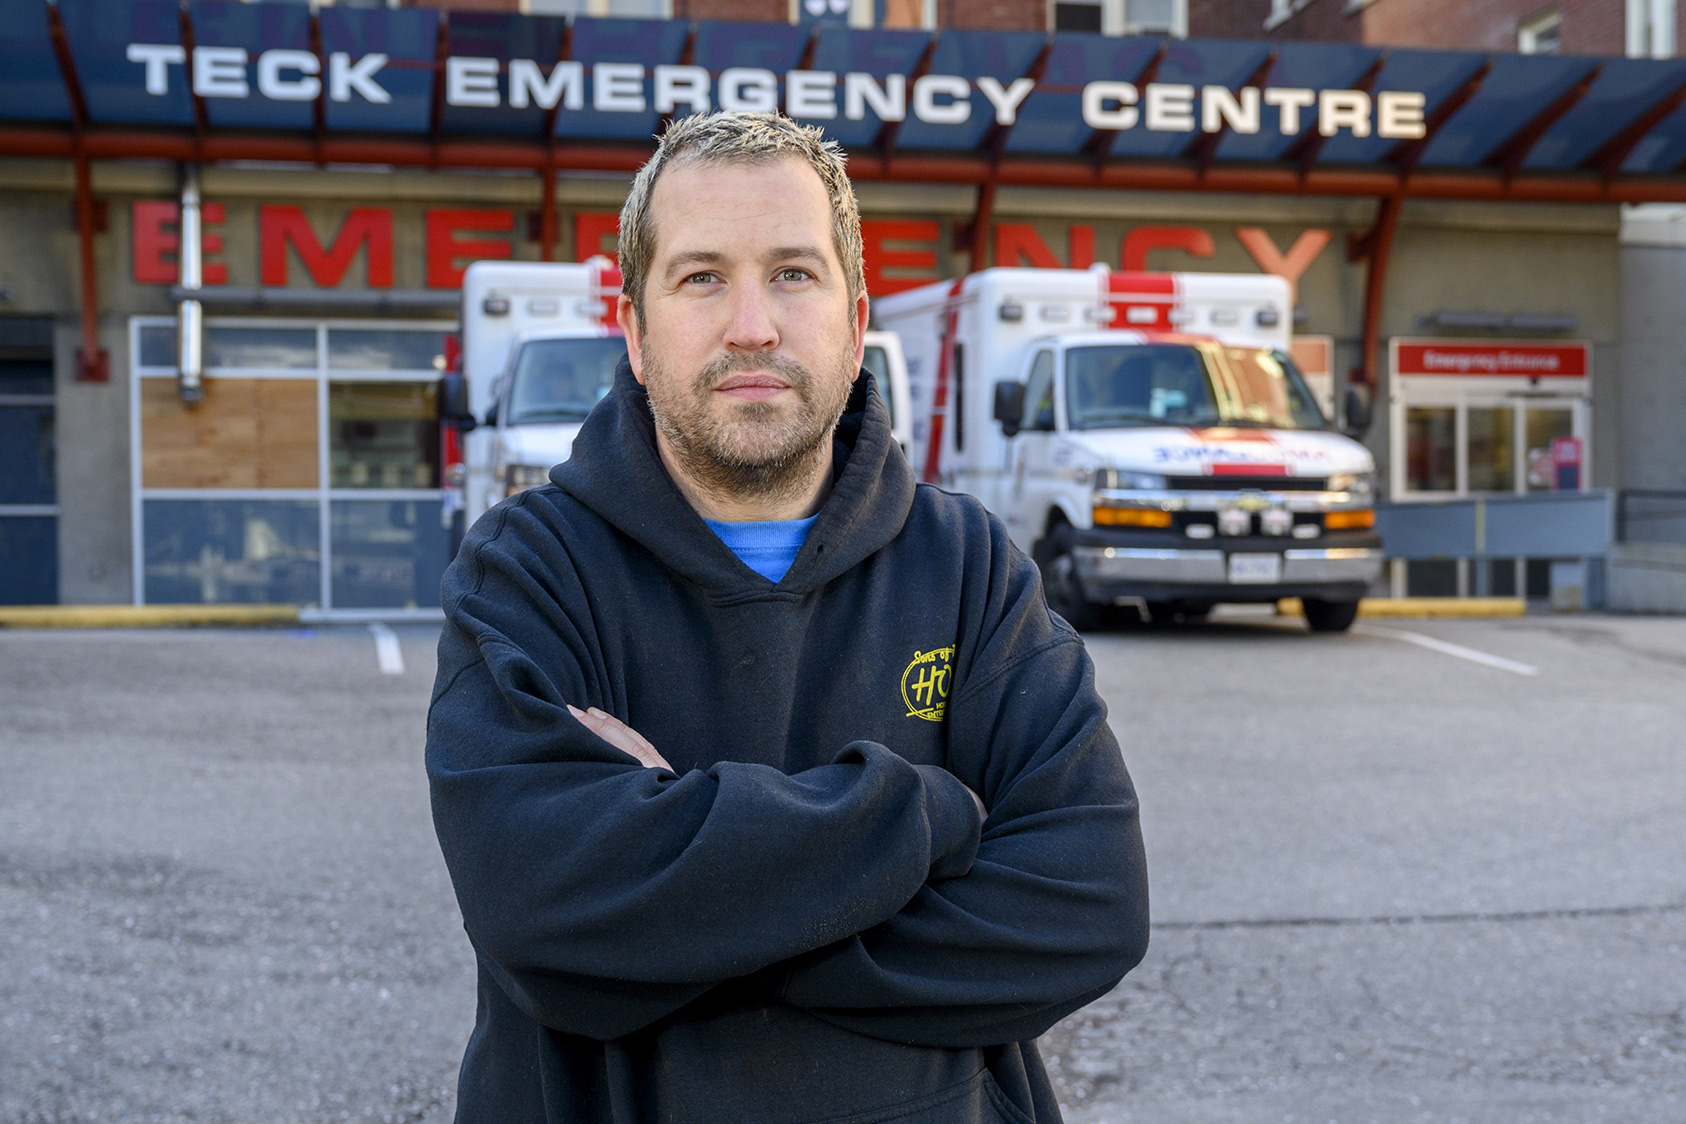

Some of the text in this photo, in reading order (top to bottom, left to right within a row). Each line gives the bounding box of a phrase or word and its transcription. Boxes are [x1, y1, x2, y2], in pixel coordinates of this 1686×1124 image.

[127, 43, 1426, 139] TECK EMERGENCY CENTRE
[131, 200, 1332, 304] EMEENCY
